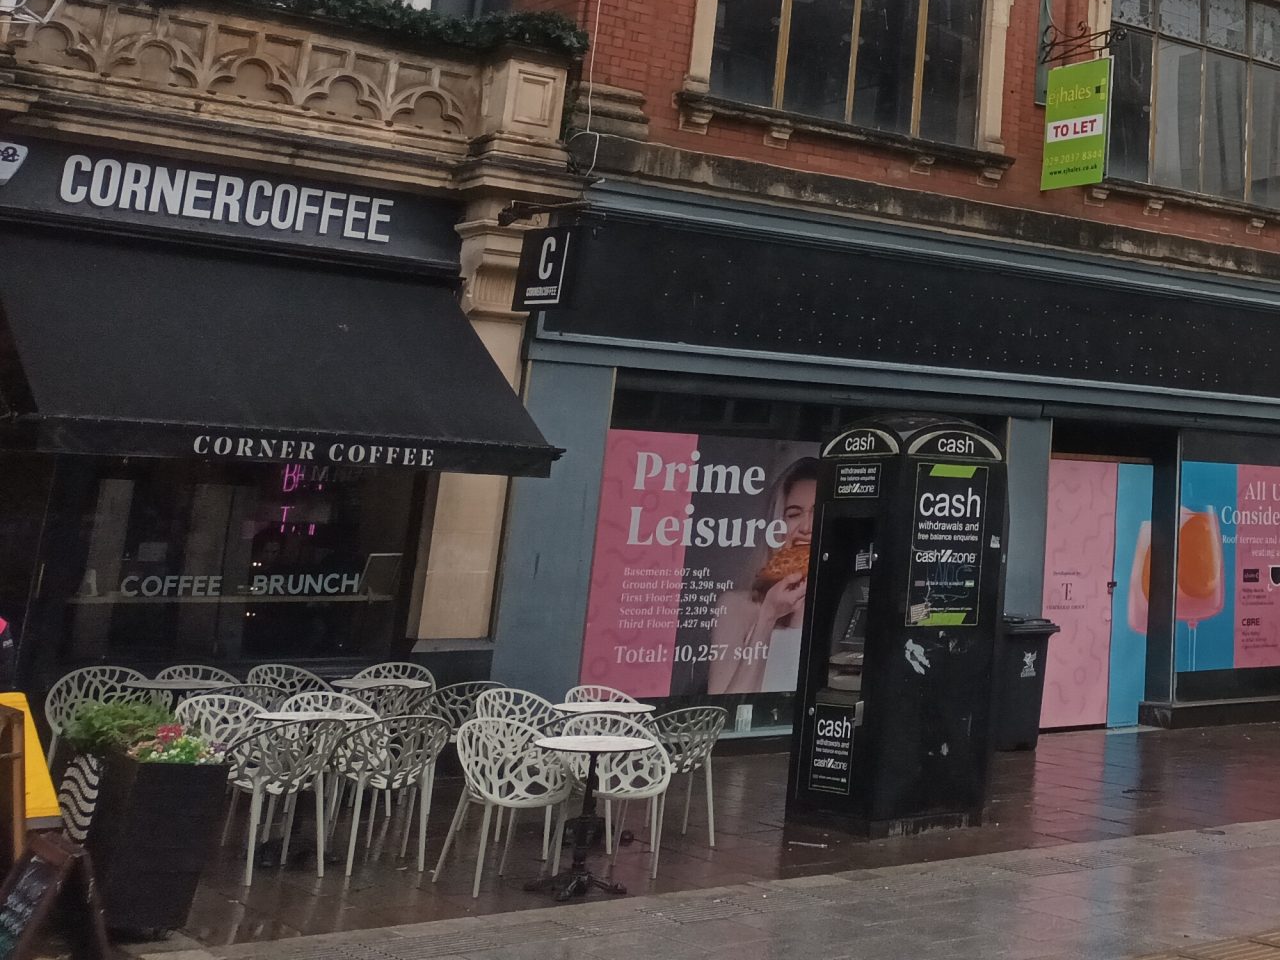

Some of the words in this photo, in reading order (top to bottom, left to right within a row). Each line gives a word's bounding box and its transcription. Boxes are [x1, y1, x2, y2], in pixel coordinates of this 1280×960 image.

[1053, 124, 1069, 138] TO
[1073, 118, 1097, 135] LET
[60, 154, 394, 243] CORNERCOFFEE
[539, 236, 557, 280] C
[193, 435, 316, 460] CORNER
[328, 443, 435, 467] COFFEE
[845, 432, 875, 451] cash
[937, 436, 974, 454] cash
[633, 450, 766, 495] Prime
[1245, 481, 1266, 500] All
[919, 487, 981, 518] cash
[626, 504, 788, 548] Leisure
[918, 521, 964, 531] withdrawals
[964, 522, 979, 531] and
[917, 532, 929, 540] free
[930, 533, 952, 541] balance
[953, 533, 979, 542] enquiries
[1265, 535, 1278, 544] and
[623, 567, 672, 577] Basement:
[674, 567, 691, 577] 607
[692, 567, 710, 579] sqft
[120, 575, 223, 597] COFFEE
[252, 573, 361, 595] BRUNCH
[622, 580, 658, 590] Ground
[660, 580, 688, 590] Floor:
[716, 579, 734, 591] sqft
[621, 593, 643, 603] First
[645, 593, 673, 603] Floor:
[699, 592, 717, 604] sqft
[619, 606, 654, 616] Second
[656, 606, 684, 616] Floor:
[709, 606, 728, 617] sqft
[619, 619, 644, 629] Third
[646, 619, 674, 629] Floor:
[700, 618, 718, 630] sqft
[1241, 617, 1261, 627] CBRE
[614, 643, 668, 664] Total:
[674, 644, 729, 664] 10,257
[733, 641, 769, 665] sqft
[817, 716, 851, 738] cash
